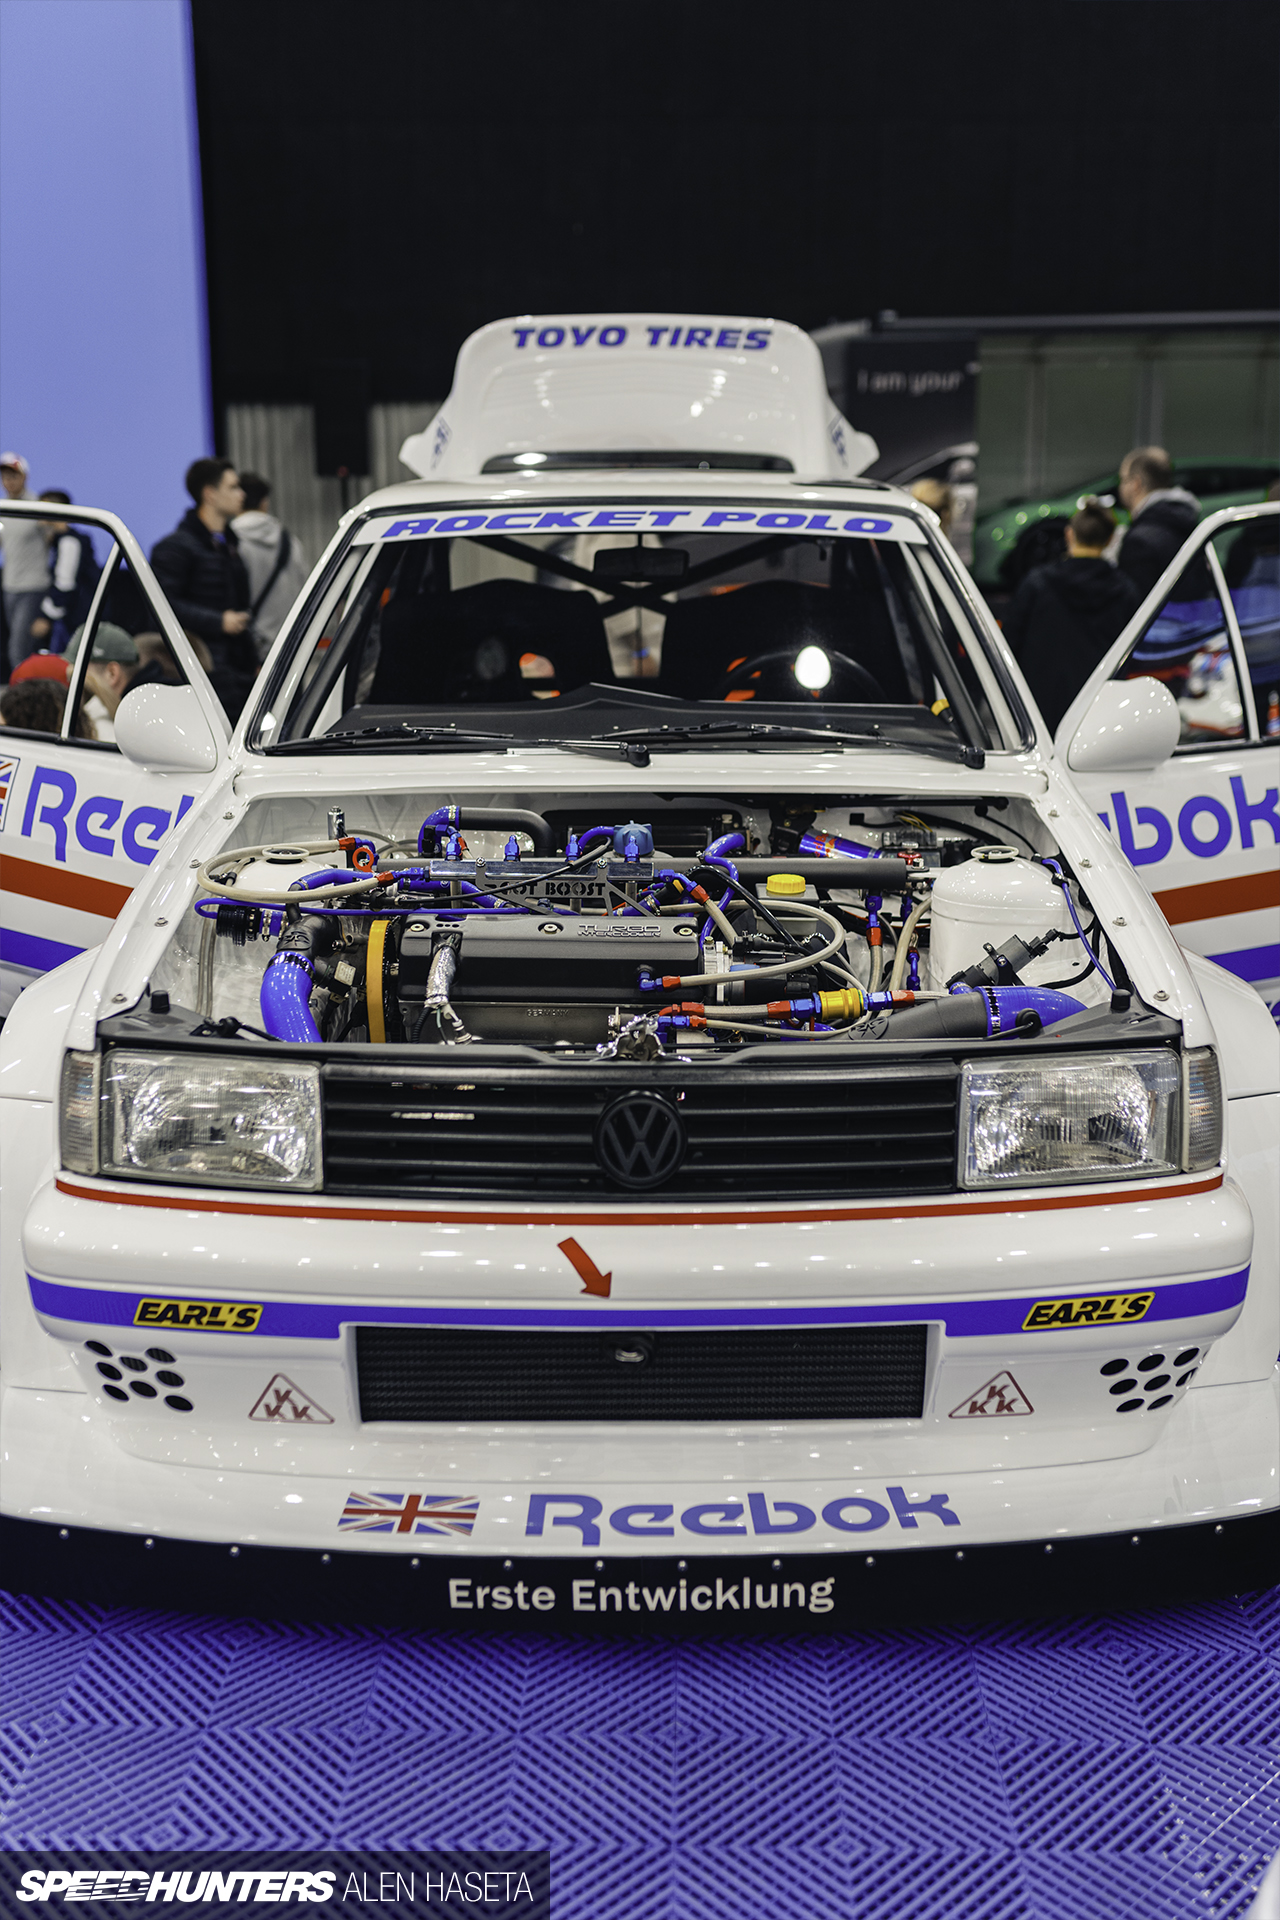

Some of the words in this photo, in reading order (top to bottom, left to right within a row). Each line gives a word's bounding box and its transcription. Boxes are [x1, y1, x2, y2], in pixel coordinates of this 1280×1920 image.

[513, 325, 628, 348] TOYO
[646, 326, 773, 350] TIRES
[380, 510, 692, 538] ROCKET
[701, 511, 894, 534] POLO
[1097, 774, 1280, 868] bok
[545, 882, 606, 896] BOOST
[576, 930, 662, 939] INTERCOOLER
[577, 923, 662, 933] TURBO
[526, 1008, 569, 1018] GERMANY
[136, 1302, 259, 1328] EARL'S
[1025, 1294, 1153, 1328] EARL'S
[525, 1485, 962, 1547] Reebok
[448, 1577, 556, 1611] Erste
[572, 1576, 836, 1614] Entwicklung
